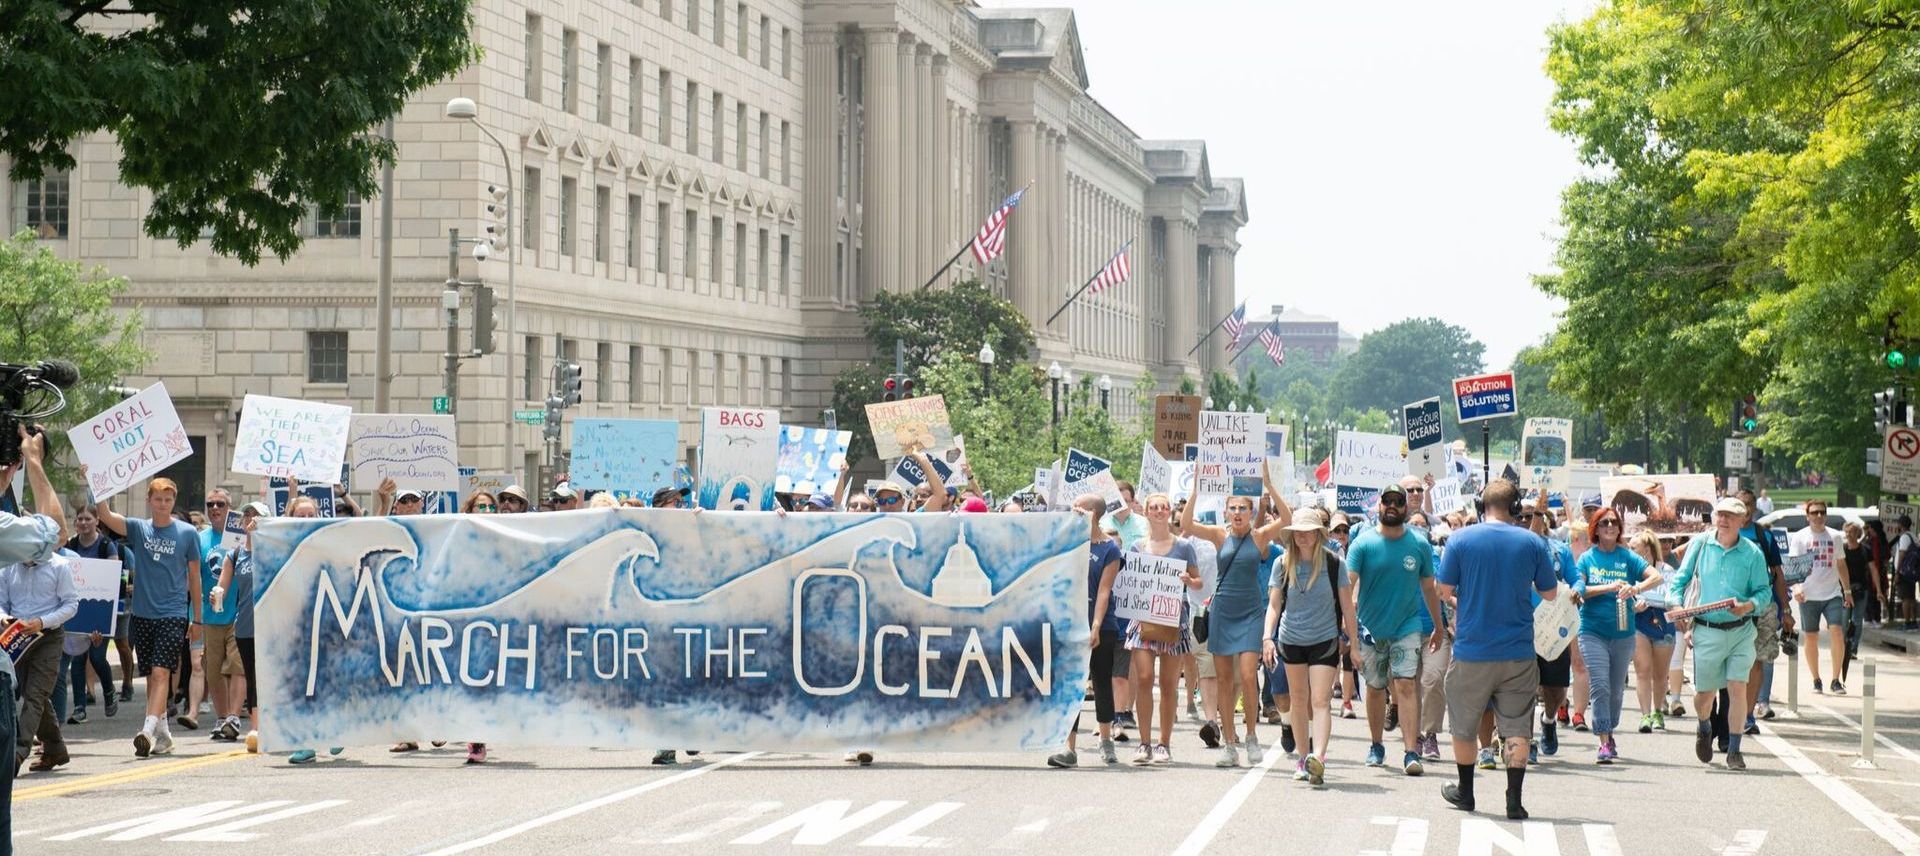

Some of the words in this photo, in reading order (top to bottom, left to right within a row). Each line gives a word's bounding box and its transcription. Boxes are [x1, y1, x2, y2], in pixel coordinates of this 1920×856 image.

[1462, 394, 1511, 408] SOLUTIONS
[93, 400, 153, 441] CORAL
[256, 406, 282, 418] WE
[293, 411, 323, 423] ARE
[719, 411, 764, 427] BAGS
[1407, 415, 1423, 429] SAVE
[1424, 411, 1439, 424] OUR
[270, 418, 301, 431] TIED
[1201, 414, 1249, 432] UNLIKE
[113, 424, 146, 453] NOT
[260, 428, 279, 439] TO
[289, 431, 315, 444] THE
[1409, 422, 1440, 441] OCEANS
[259, 439, 307, 466] SEA
[1167, 443, 1183, 454] WE
[114, 447, 162, 479] COAL
[1070, 459, 1088, 472] SAVE
[1202, 465, 1221, 477] NOT
[1226, 465, 1245, 477] have
[903, 460, 927, 483] OCEA
[1068, 469, 1086, 479] OCE
[1200, 477, 1230, 493] Filter!
[1886, 505, 1914, 516] STOP
[144, 542, 175, 555] OCEANS
[1140, 579, 1154, 594] got
[1115, 593, 1128, 608] nd
[1151, 595, 1181, 618] PISSED
[306, 566, 537, 697] MARCH
[566, 627, 651, 680] FOR
[673, 628, 768, 679] THE
[793, 567, 1052, 698] OCEAN
